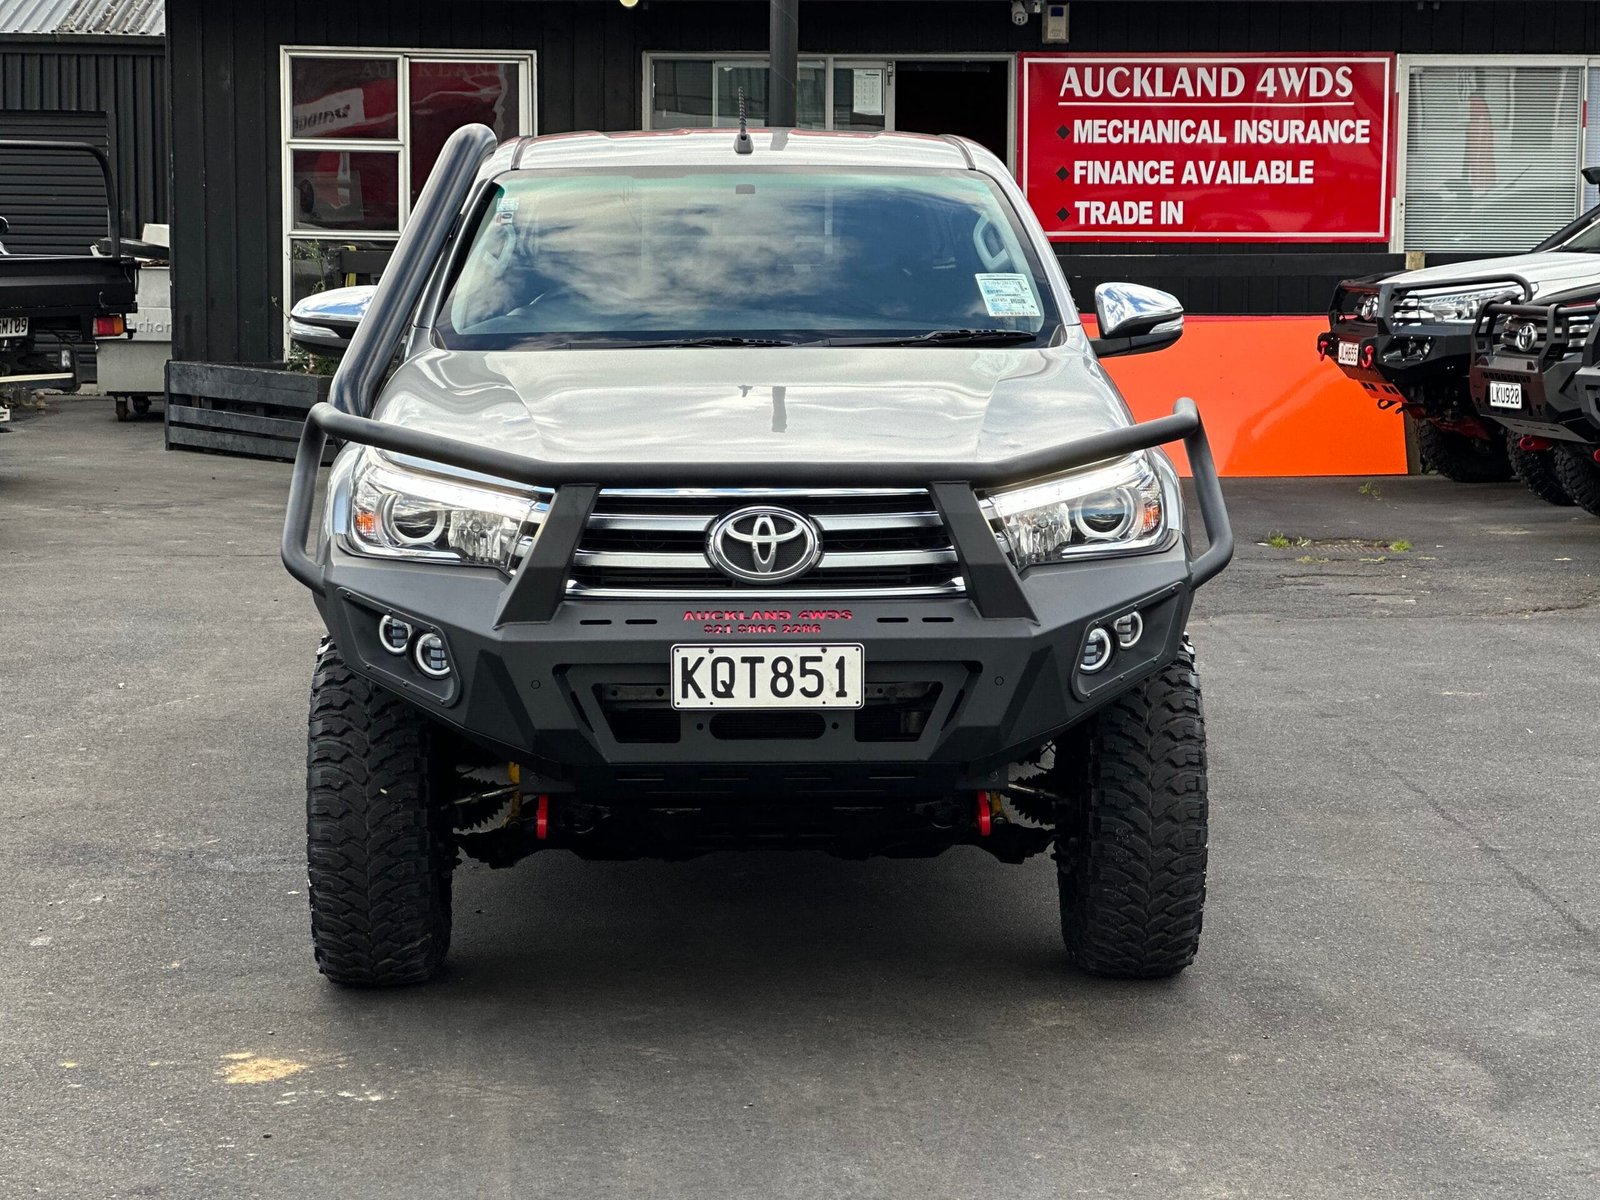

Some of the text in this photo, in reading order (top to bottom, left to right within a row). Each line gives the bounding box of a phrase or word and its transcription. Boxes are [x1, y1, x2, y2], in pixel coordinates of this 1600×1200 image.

[1060, 66, 1354, 98] AUCKLAND 4WDS
[1073, 119, 1371, 144] MECHANICAL INSURANCE
[1073, 160, 1315, 185] FINANCE AVAILABLE
[1074, 200, 1184, 225] TRADE IN
[0, 318, 27, 334] M109
[1491, 383, 1520, 405] LKU920
[683, 609, 853, 621] AUCKLAND 4WDS
[703, 624, 733, 634] 021
[681, 656, 848, 699] KQT851
